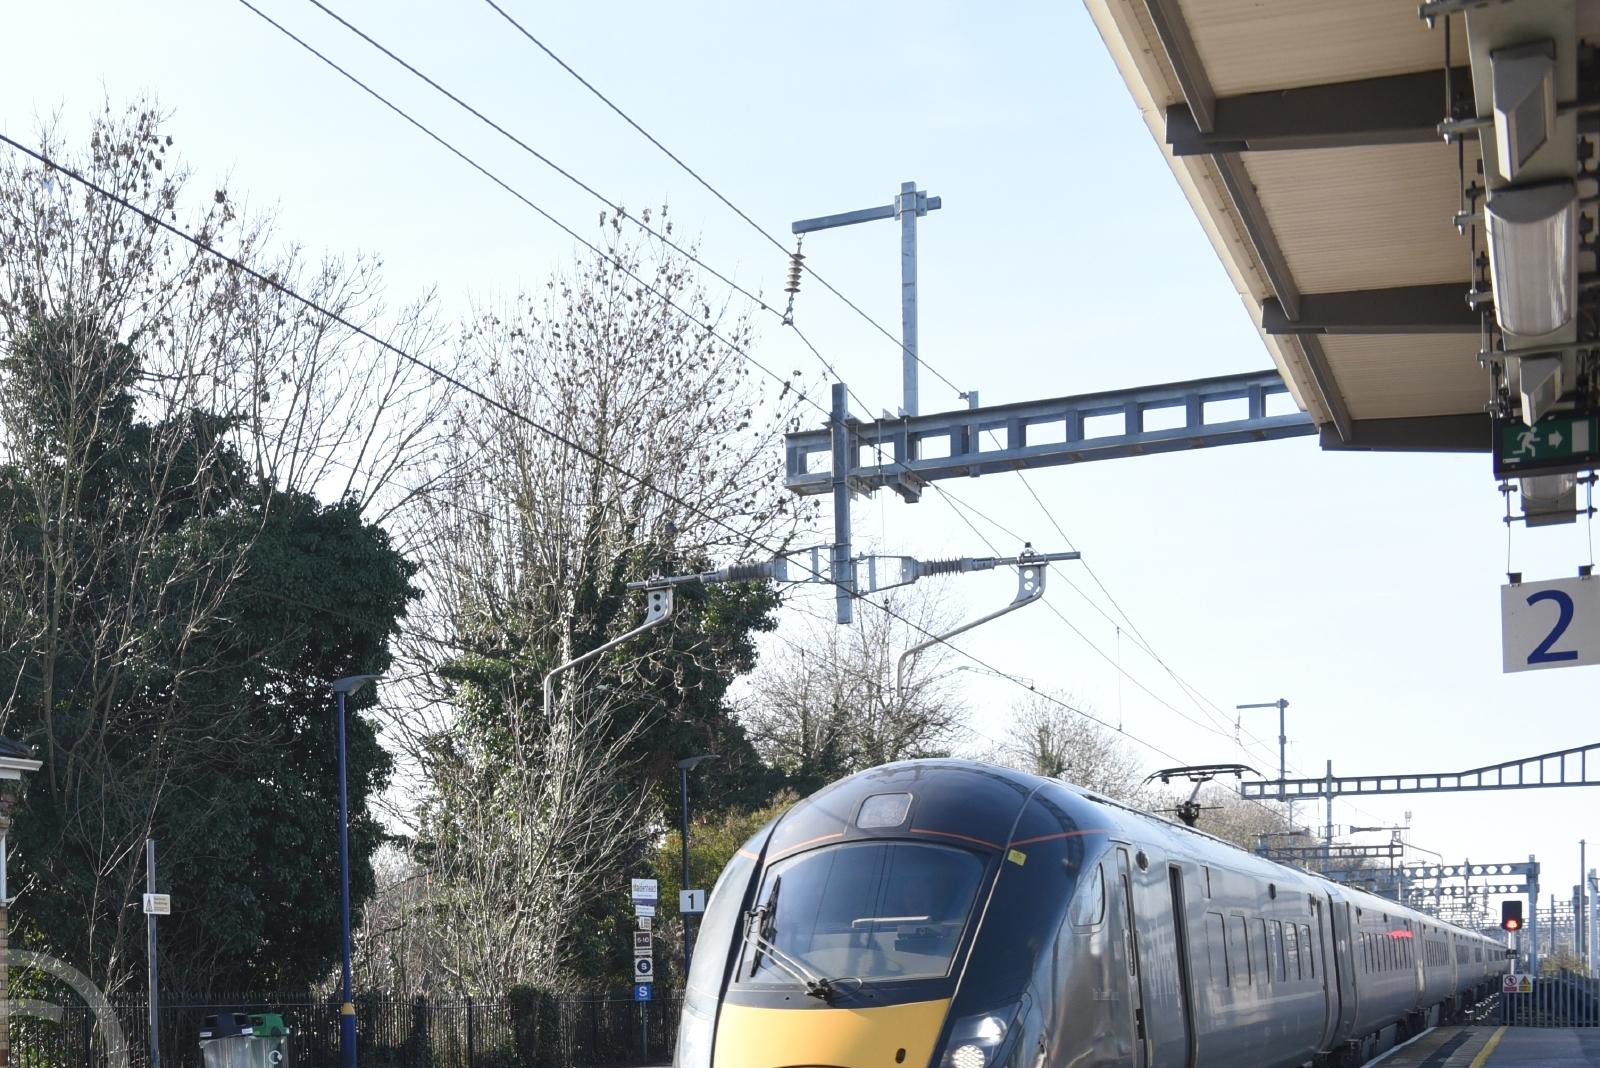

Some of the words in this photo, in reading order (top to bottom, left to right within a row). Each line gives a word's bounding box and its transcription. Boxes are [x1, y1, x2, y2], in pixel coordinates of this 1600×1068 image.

[1526, 590, 1578, 664] 2
[687, 893, 694, 910] 1
[641, 962, 648, 970] S
[639, 986, 648, 997] S
